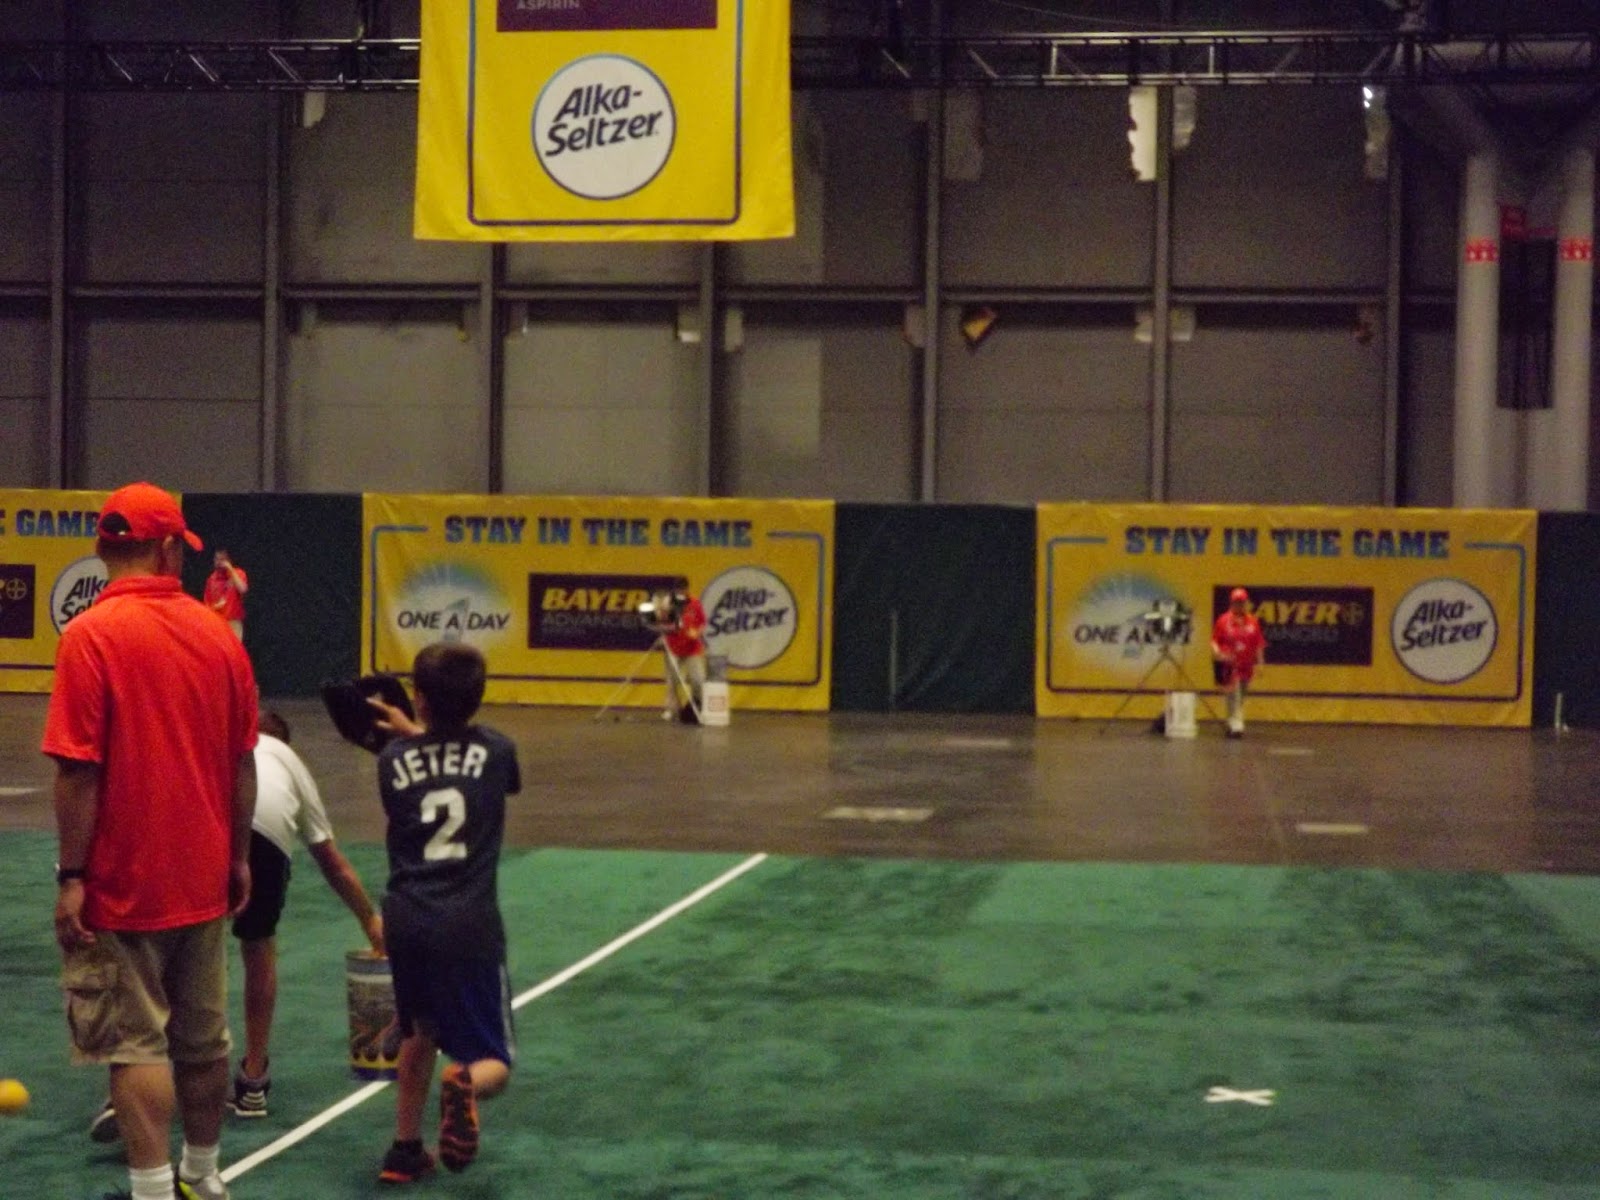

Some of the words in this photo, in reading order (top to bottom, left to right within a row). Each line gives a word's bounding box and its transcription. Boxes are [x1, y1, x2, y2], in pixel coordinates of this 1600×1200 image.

[552, 83, 642, 123] Alka-
[545, 110, 663, 157] Seltzer
[445, 515, 526, 544] STAY
[538, 516, 571, 545] IN
[582, 517, 649, 546] THE
[660, 518, 753, 547] GAME
[1125, 525, 1212, 555] STAY
[1222, 526, 1258, 555] IN
[1269, 527, 1342, 557] THE
[1353, 528, 1450, 559] GAME
[64, 575, 109, 602] Alk
[397, 610, 441, 630] ONE
[446, 612, 460, 630] A
[467, 611, 511, 631] DAY
[706, 606, 789, 638] Seltzer
[1245, 600, 1341, 625] AYER
[1408, 598, 1474, 625] Alka-
[1075, 624, 1119, 644] ONE
[1401, 620, 1487, 651] Seltzer
[392, 742, 488, 790] JETER
[420, 787, 468, 861] 2
